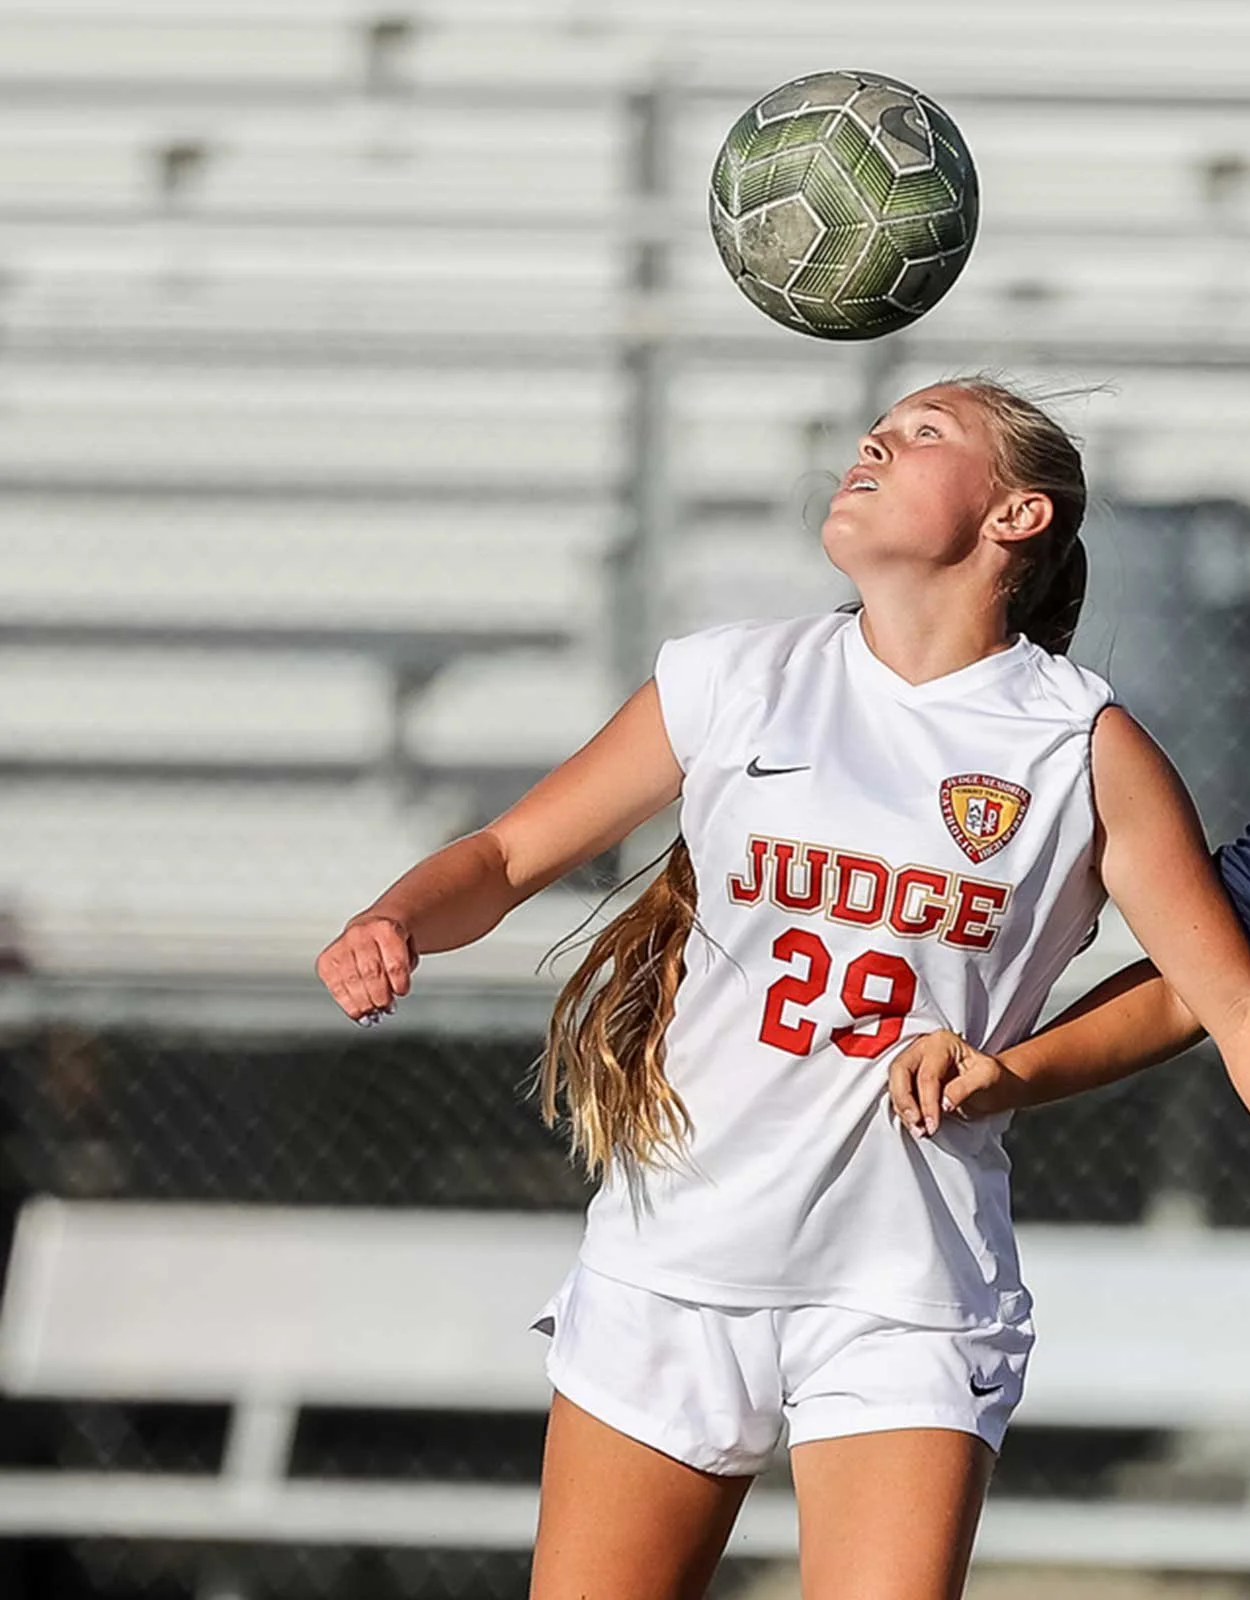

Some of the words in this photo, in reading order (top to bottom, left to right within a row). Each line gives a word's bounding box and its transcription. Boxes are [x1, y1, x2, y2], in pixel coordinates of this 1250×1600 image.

[941, 788, 976, 857] CATHOLIC
[727, 833, 1013, 953] JUDGE
[757, 927, 918, 1059] 29
